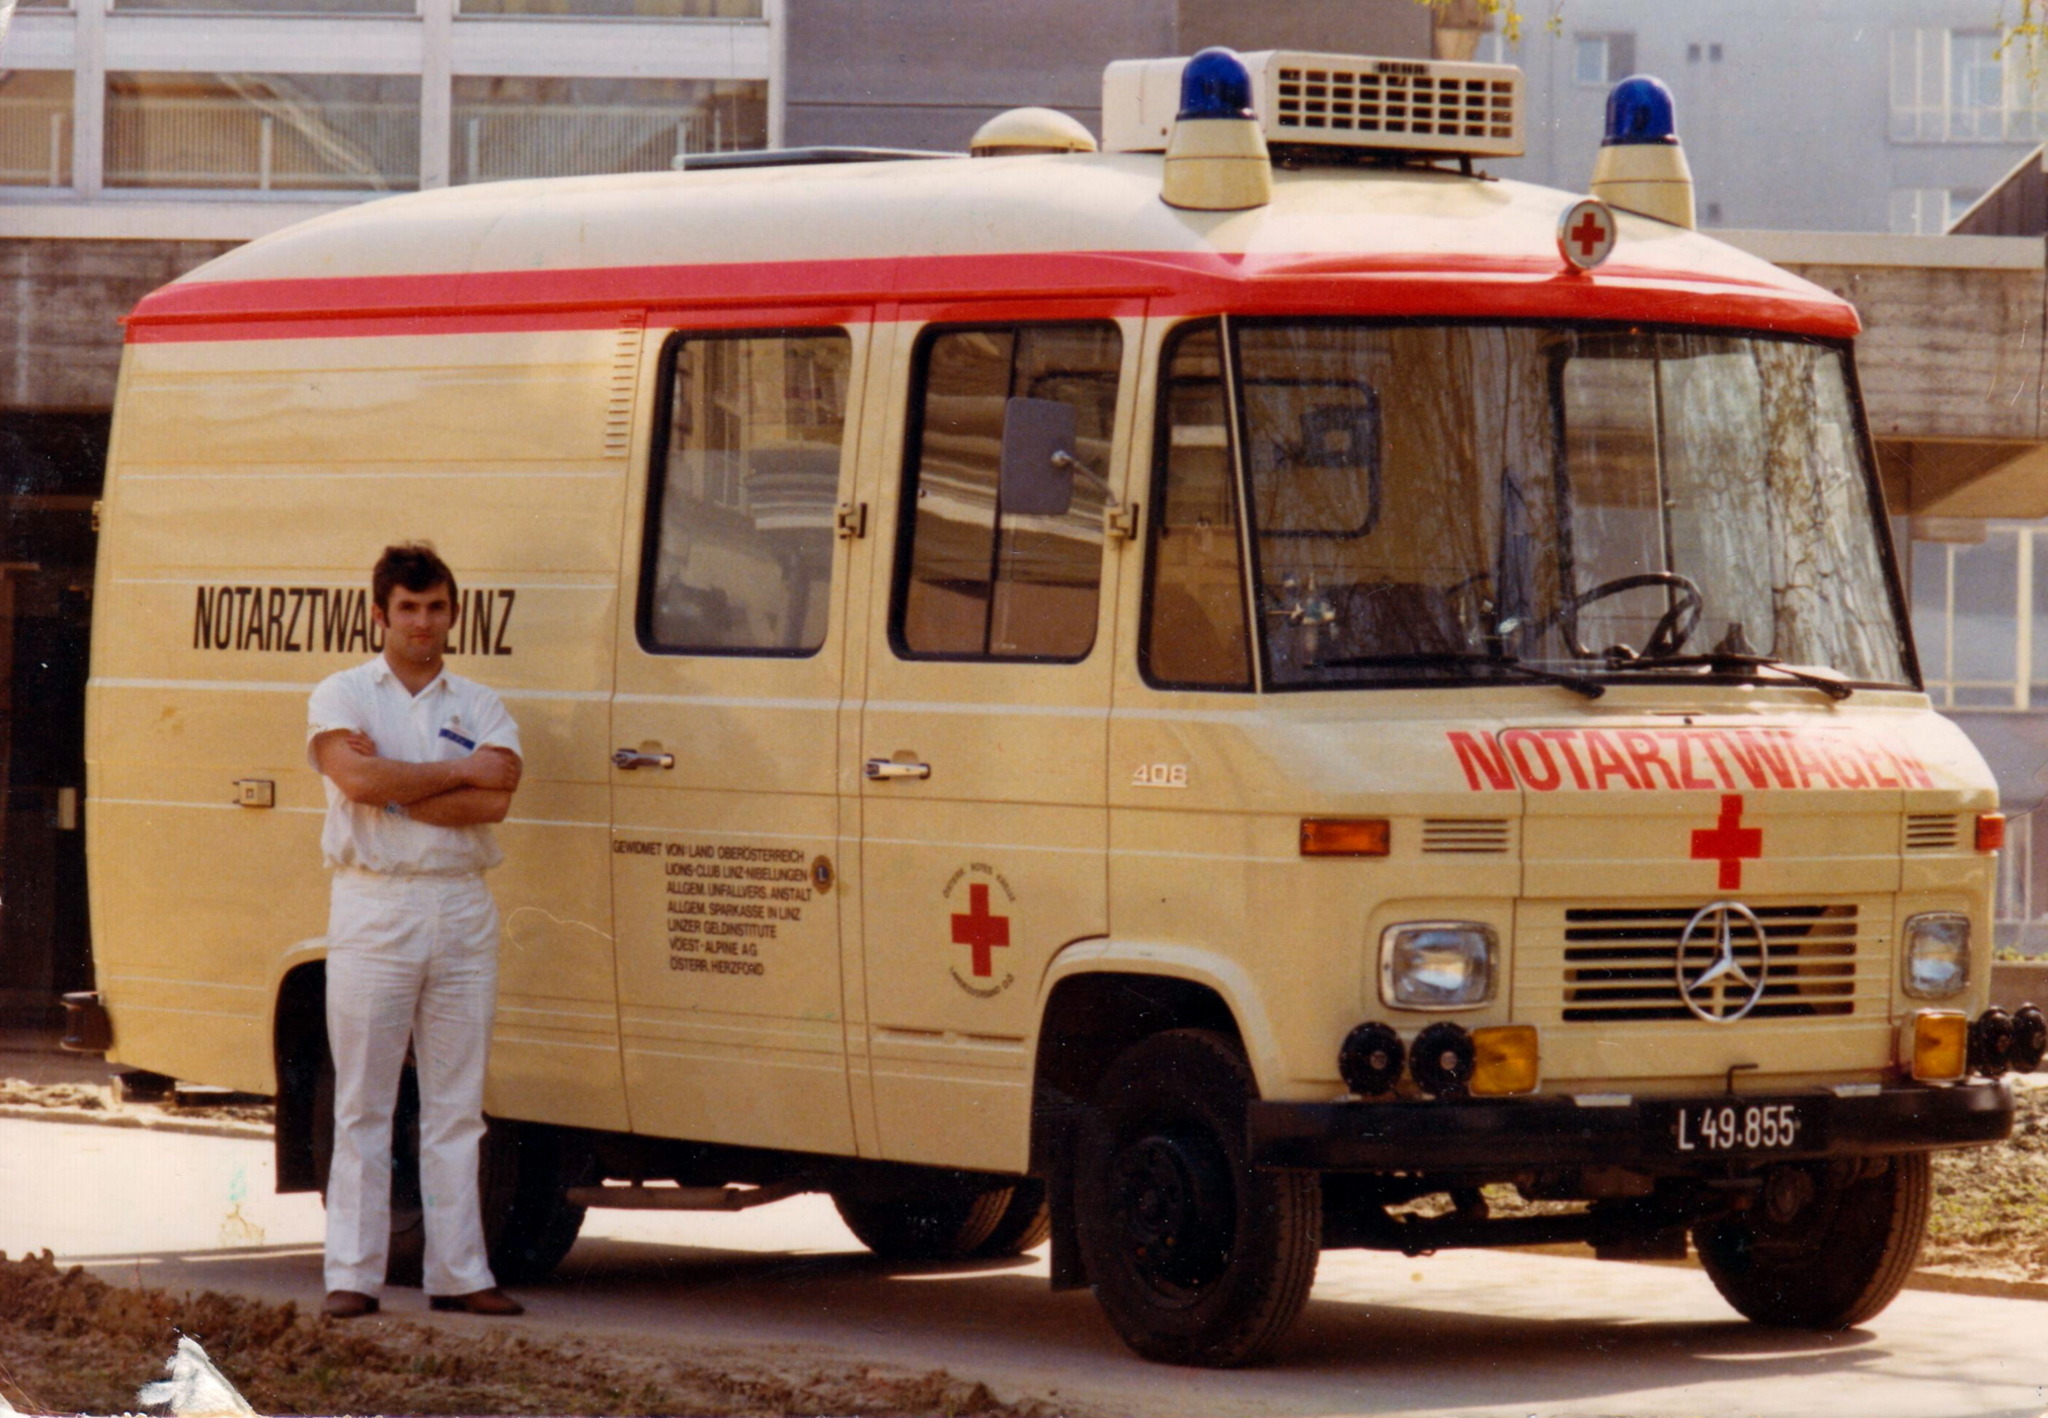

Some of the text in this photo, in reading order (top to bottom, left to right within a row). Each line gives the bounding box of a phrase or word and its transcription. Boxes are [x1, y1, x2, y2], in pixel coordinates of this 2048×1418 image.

[193, 586, 384, 653] NOTARZTWA
[1446, 730, 1934, 792] NOTARZTWAGEN
[1132, 763, 1188, 788] 408
[613, 839, 805, 863] GEWIDMET VON LAND OBERÖSTERREICH
[770, 886, 812, 902] ANSTALT
[708, 902, 765, 918] SPARKASSE
[767, 905, 777, 919] IN
[779, 907, 801, 921] LINZ
[667, 919, 777, 939] LINZER GELDINSTITUTE
[1678, 1109, 1695, 1149] L
